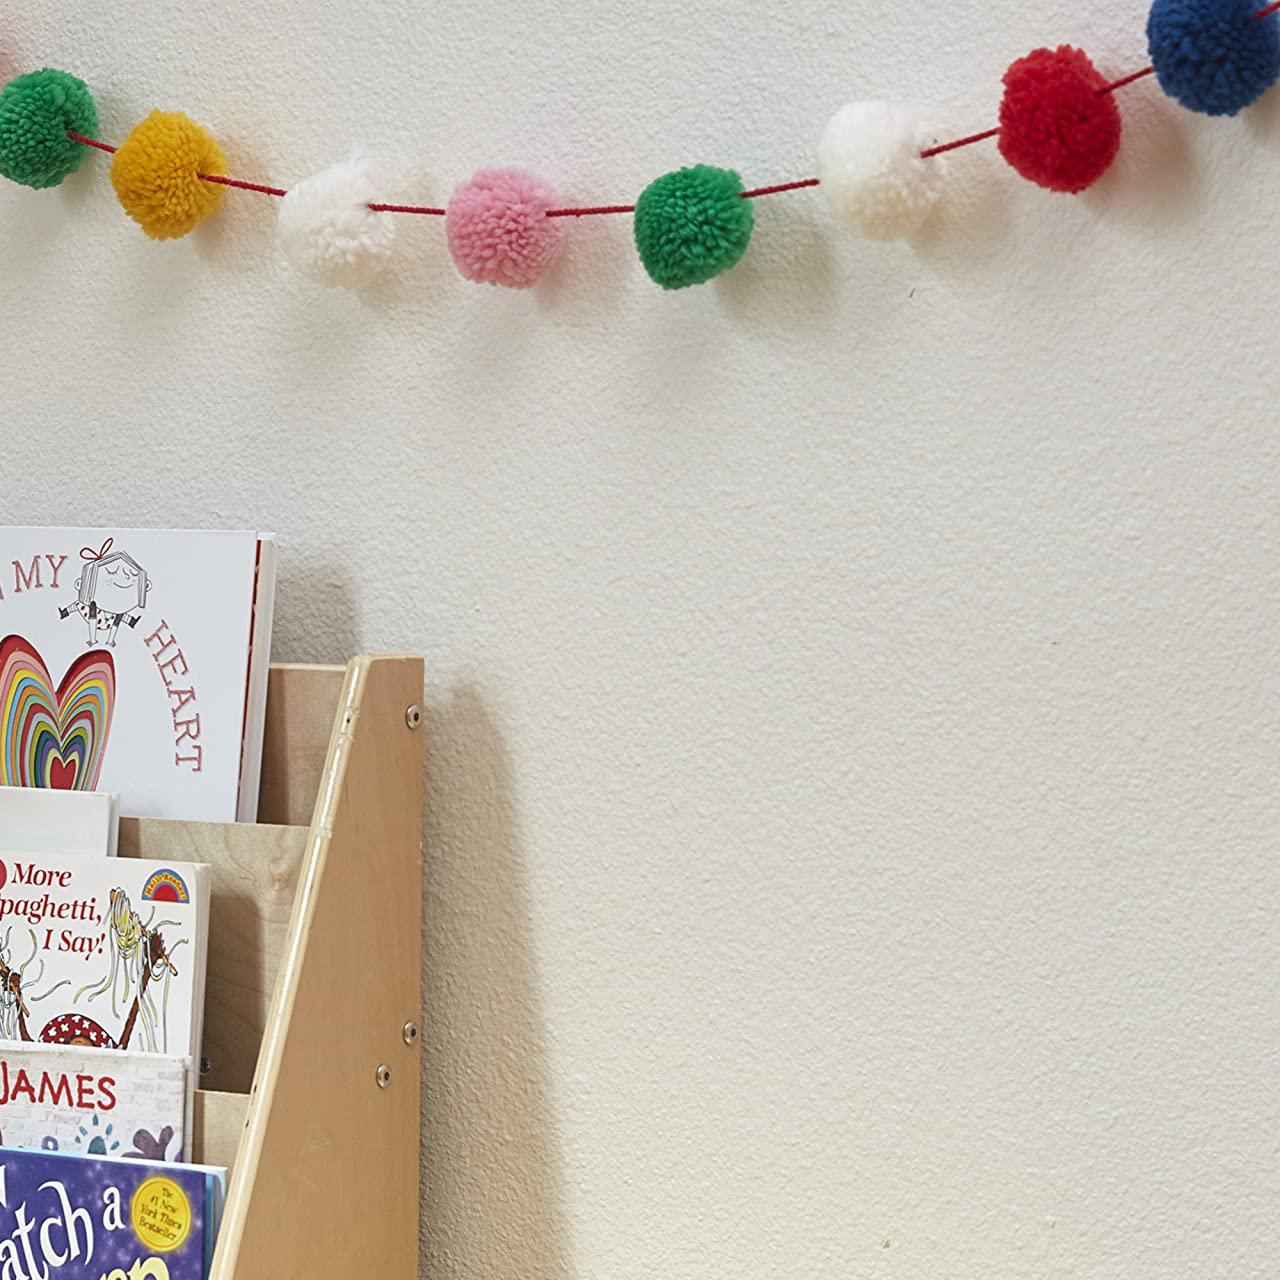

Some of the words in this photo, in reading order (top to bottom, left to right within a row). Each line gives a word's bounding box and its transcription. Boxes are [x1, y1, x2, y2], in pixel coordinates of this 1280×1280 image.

[12, 555, 68, 593] MY
[144, 619, 202, 772] HEART
[11, 863, 72, 887] More
[44, 929, 55, 950] I
[56, 929, 105, 961] Say!
[102, 1185, 125, 1230] a
